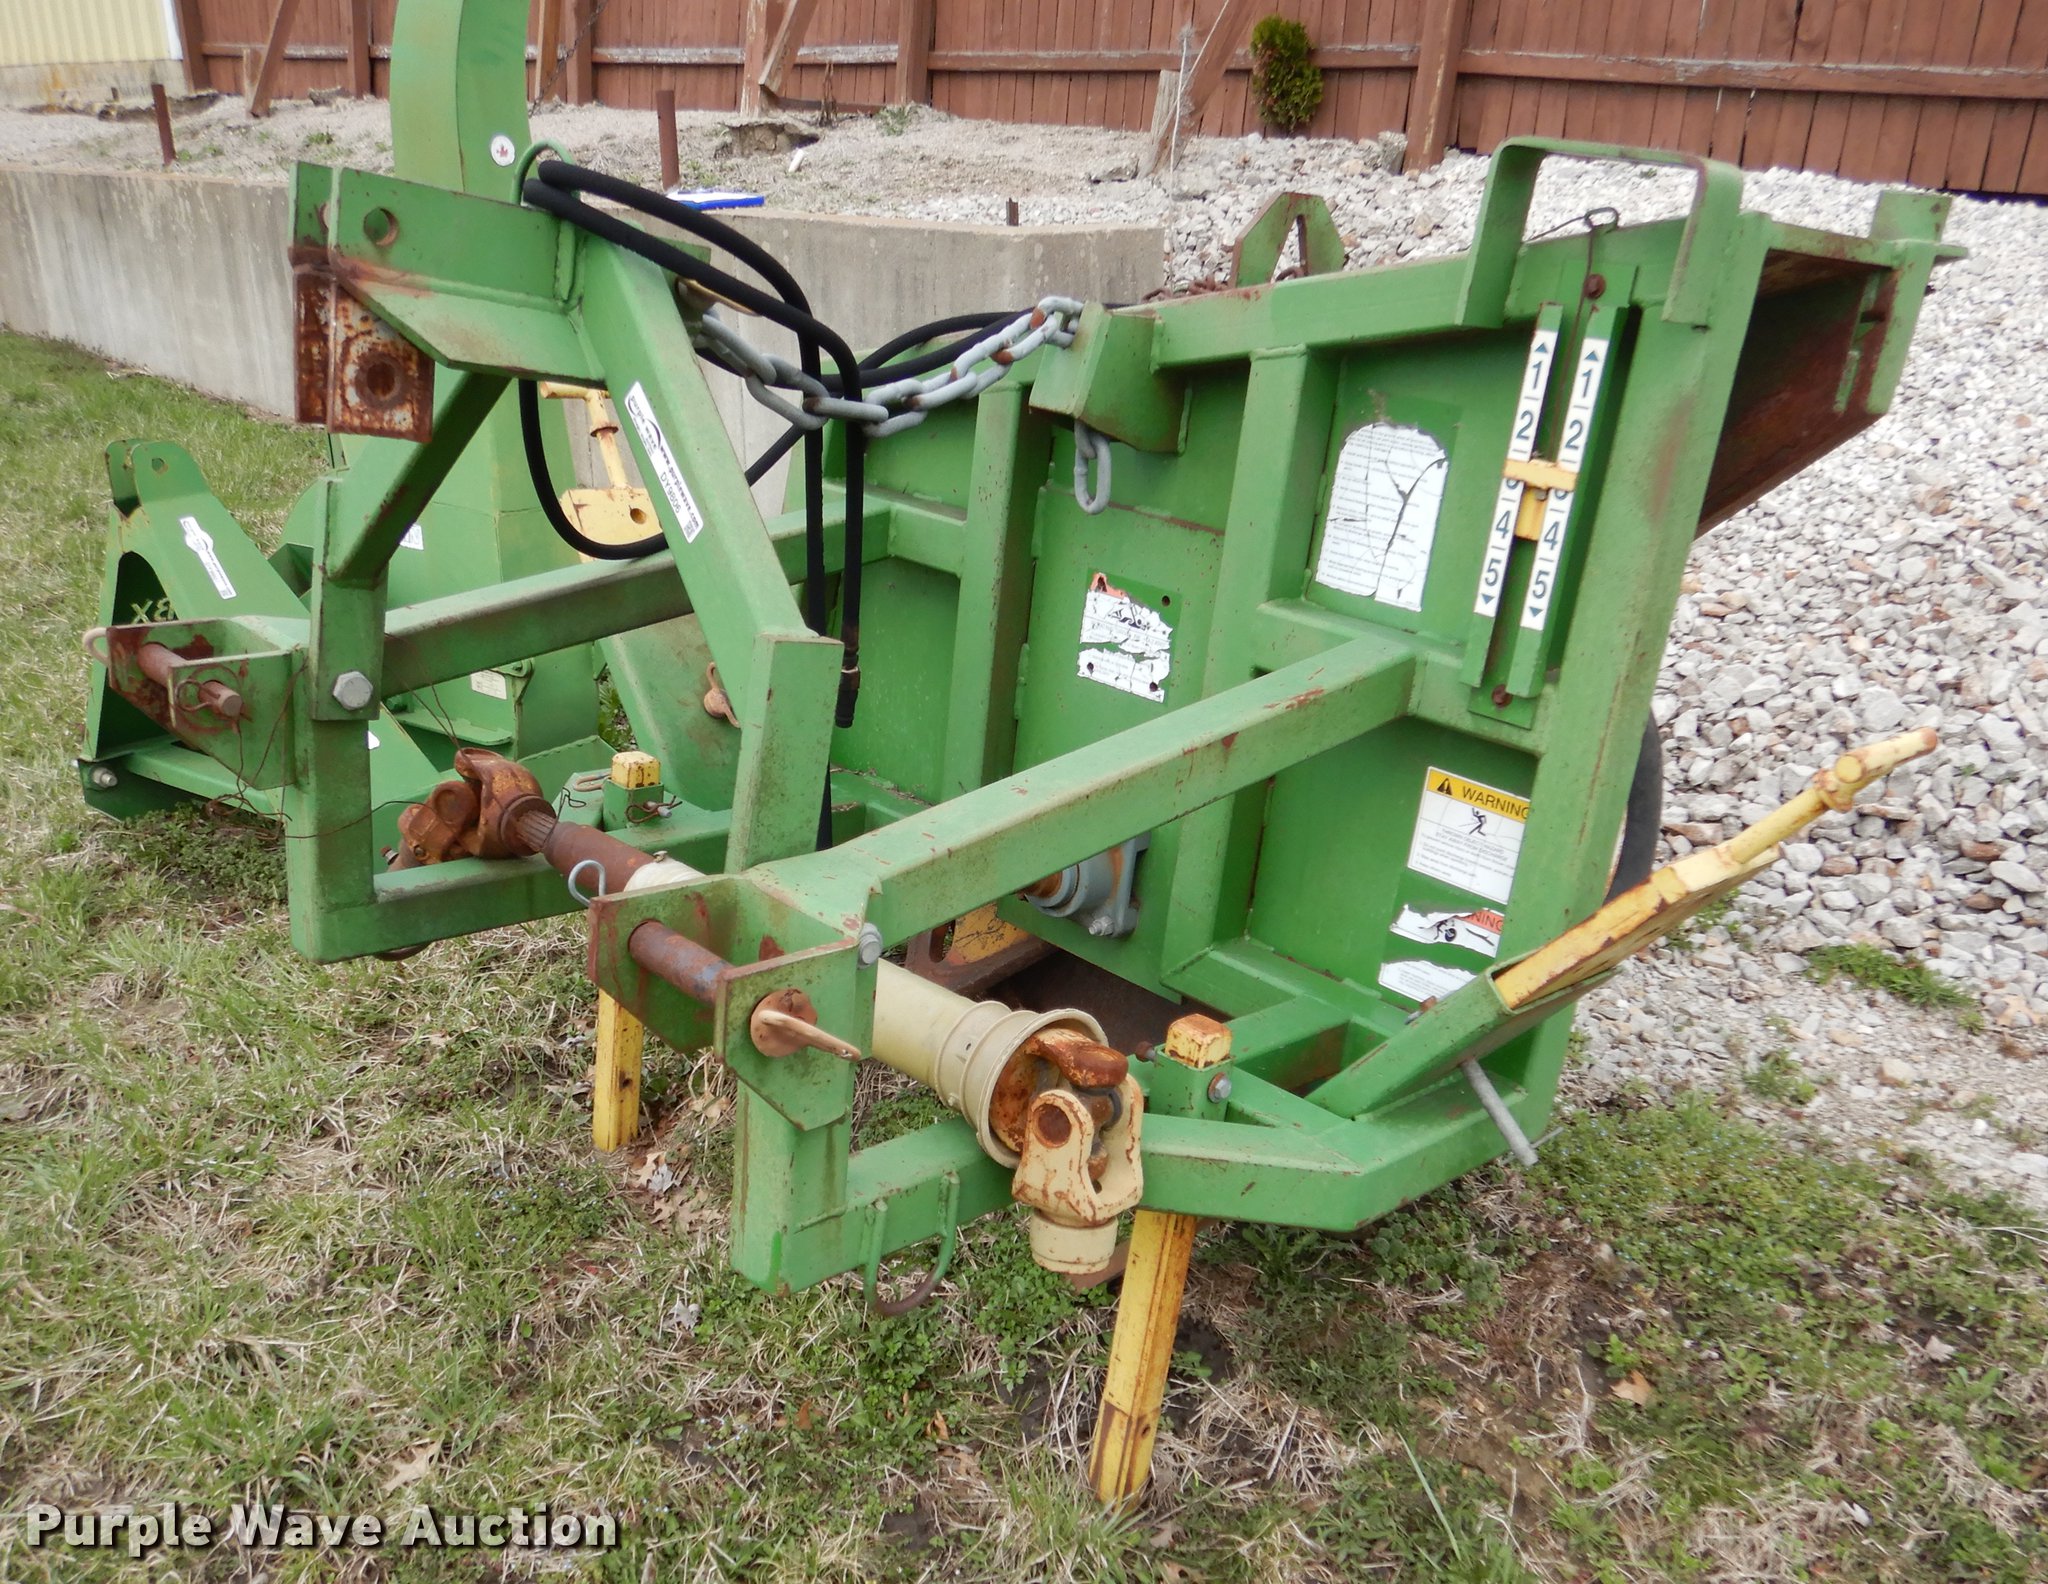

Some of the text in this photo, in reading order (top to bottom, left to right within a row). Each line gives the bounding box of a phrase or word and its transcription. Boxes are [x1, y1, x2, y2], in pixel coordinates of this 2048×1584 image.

[1485, 361, 1542, 586] 1 2 4 5
[1532, 369, 1593, 599] 1 2 4 5
